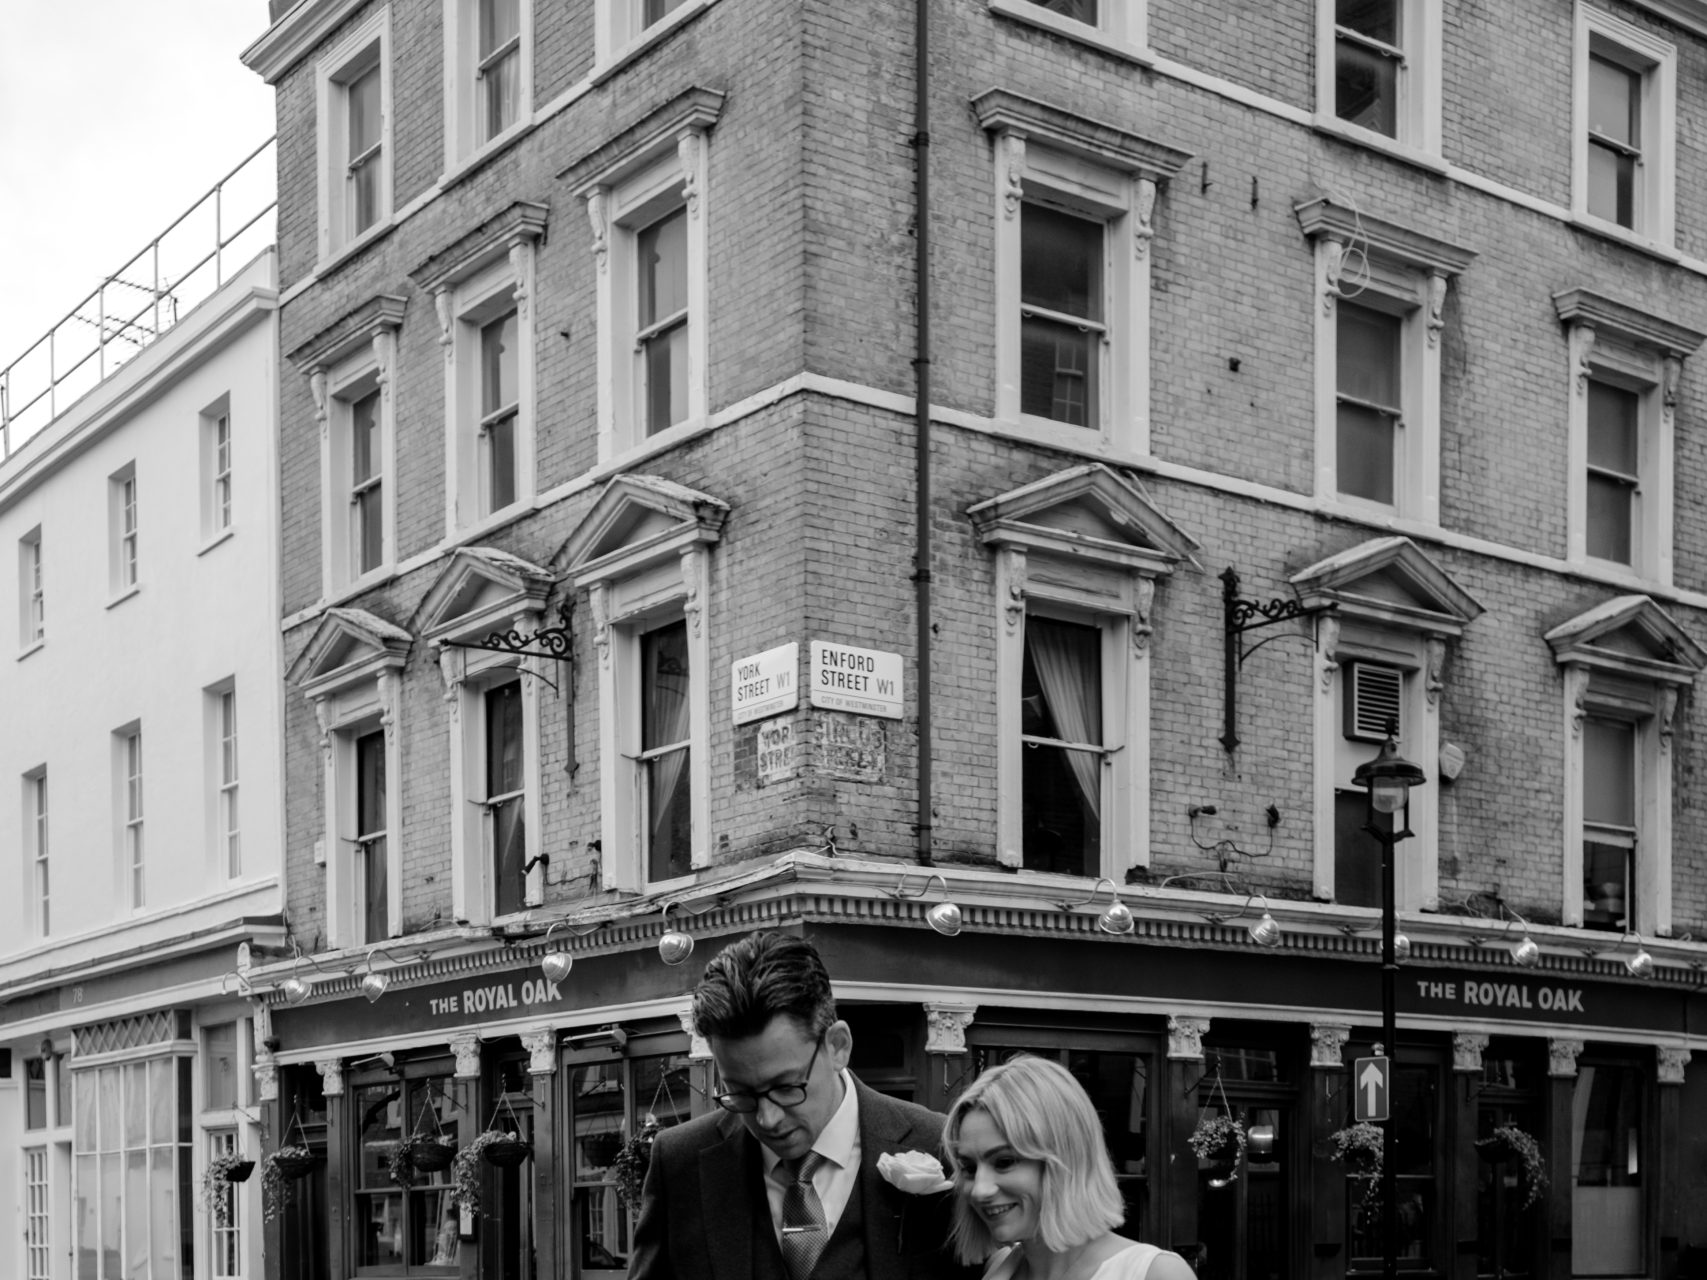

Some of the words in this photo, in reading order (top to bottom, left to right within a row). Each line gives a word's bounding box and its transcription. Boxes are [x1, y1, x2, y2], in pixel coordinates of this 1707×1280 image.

[738, 662, 760, 682] YORK
[822, 649, 874, 672] ENFORD
[738, 678, 770, 702] STREET
[776, 671, 790, 689] W1
[821, 670, 869, 692] STREET
[877, 678, 894, 696] W1
[822, 696, 834, 704] CITY
[845, 700, 887, 712] WESTMINSTER
[72, 988, 83, 1003] 78
[430, 996, 459, 1015] THE
[463, 984, 518, 1014] ROYAL
[521, 978, 562, 1005] OAK
[1416, 981, 1456, 999] THE
[1464, 980, 1532, 1008] ROYAL
[1538, 986, 1584, 1012] OAK
